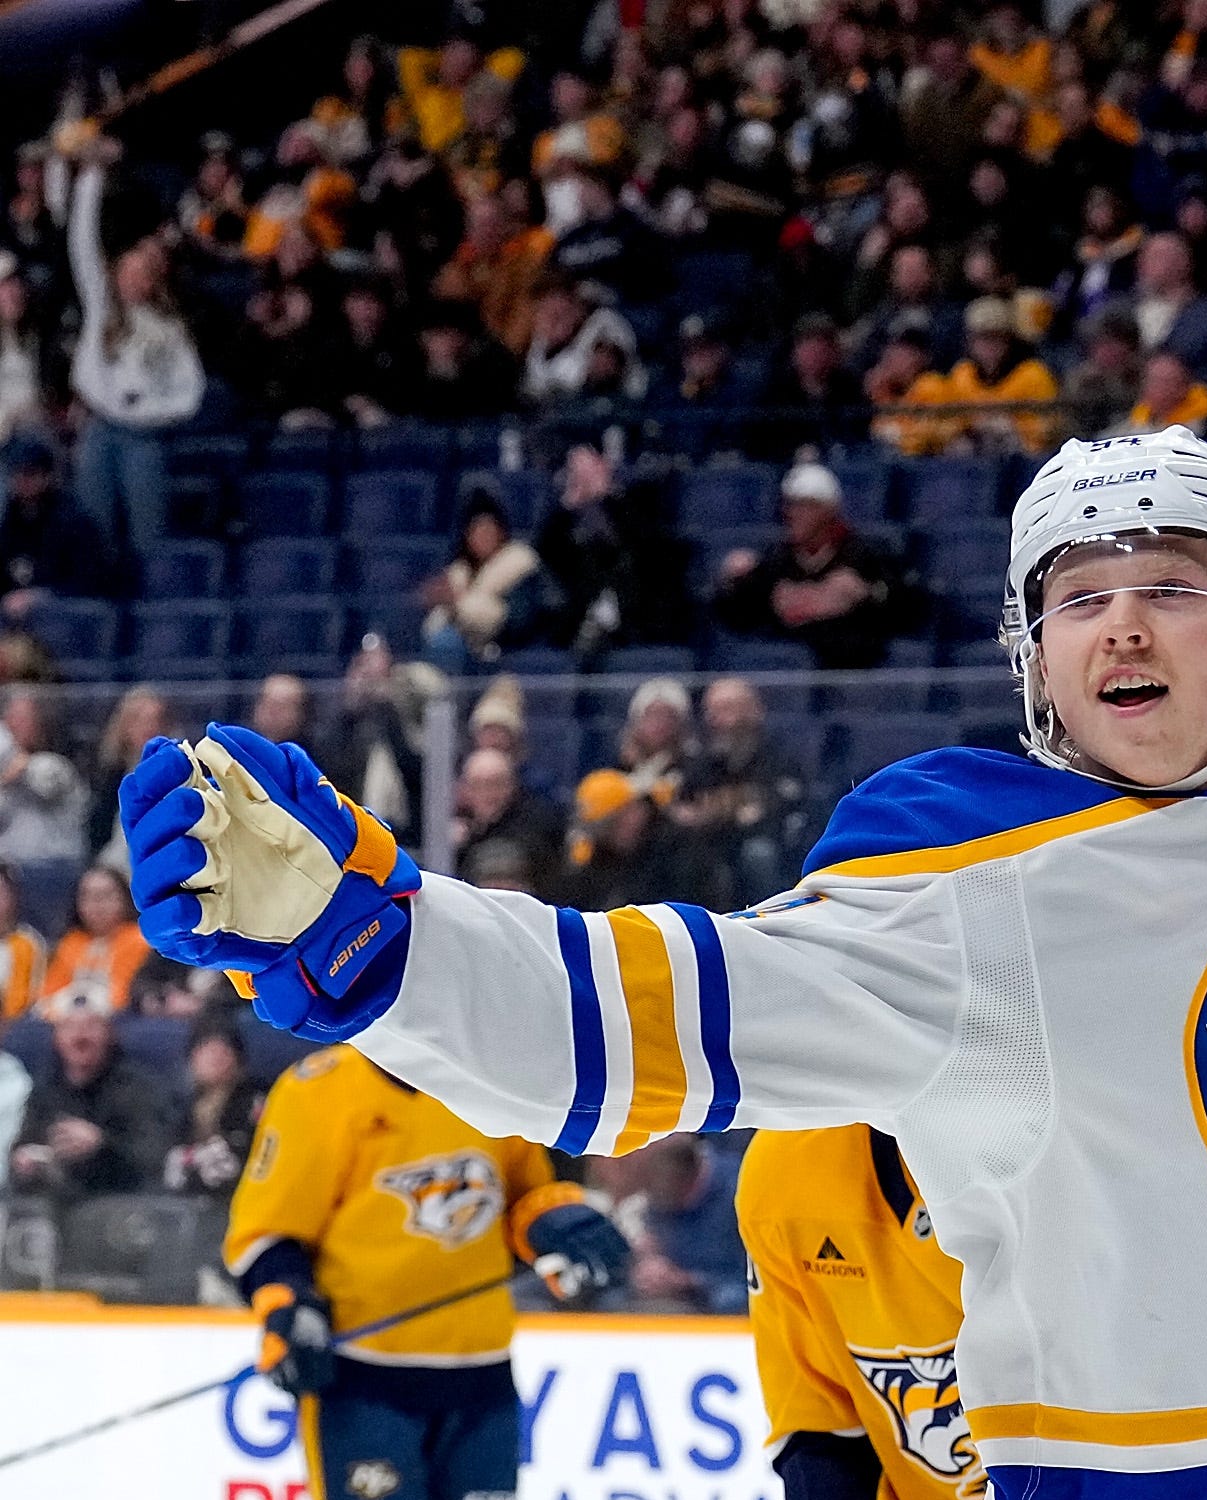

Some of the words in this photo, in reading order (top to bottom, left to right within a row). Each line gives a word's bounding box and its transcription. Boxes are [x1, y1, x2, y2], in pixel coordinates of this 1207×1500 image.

[1072, 468, 1157, 492] BAUER
[329, 919, 381, 977] BAUER
[224, 1364, 557, 1467] GY
